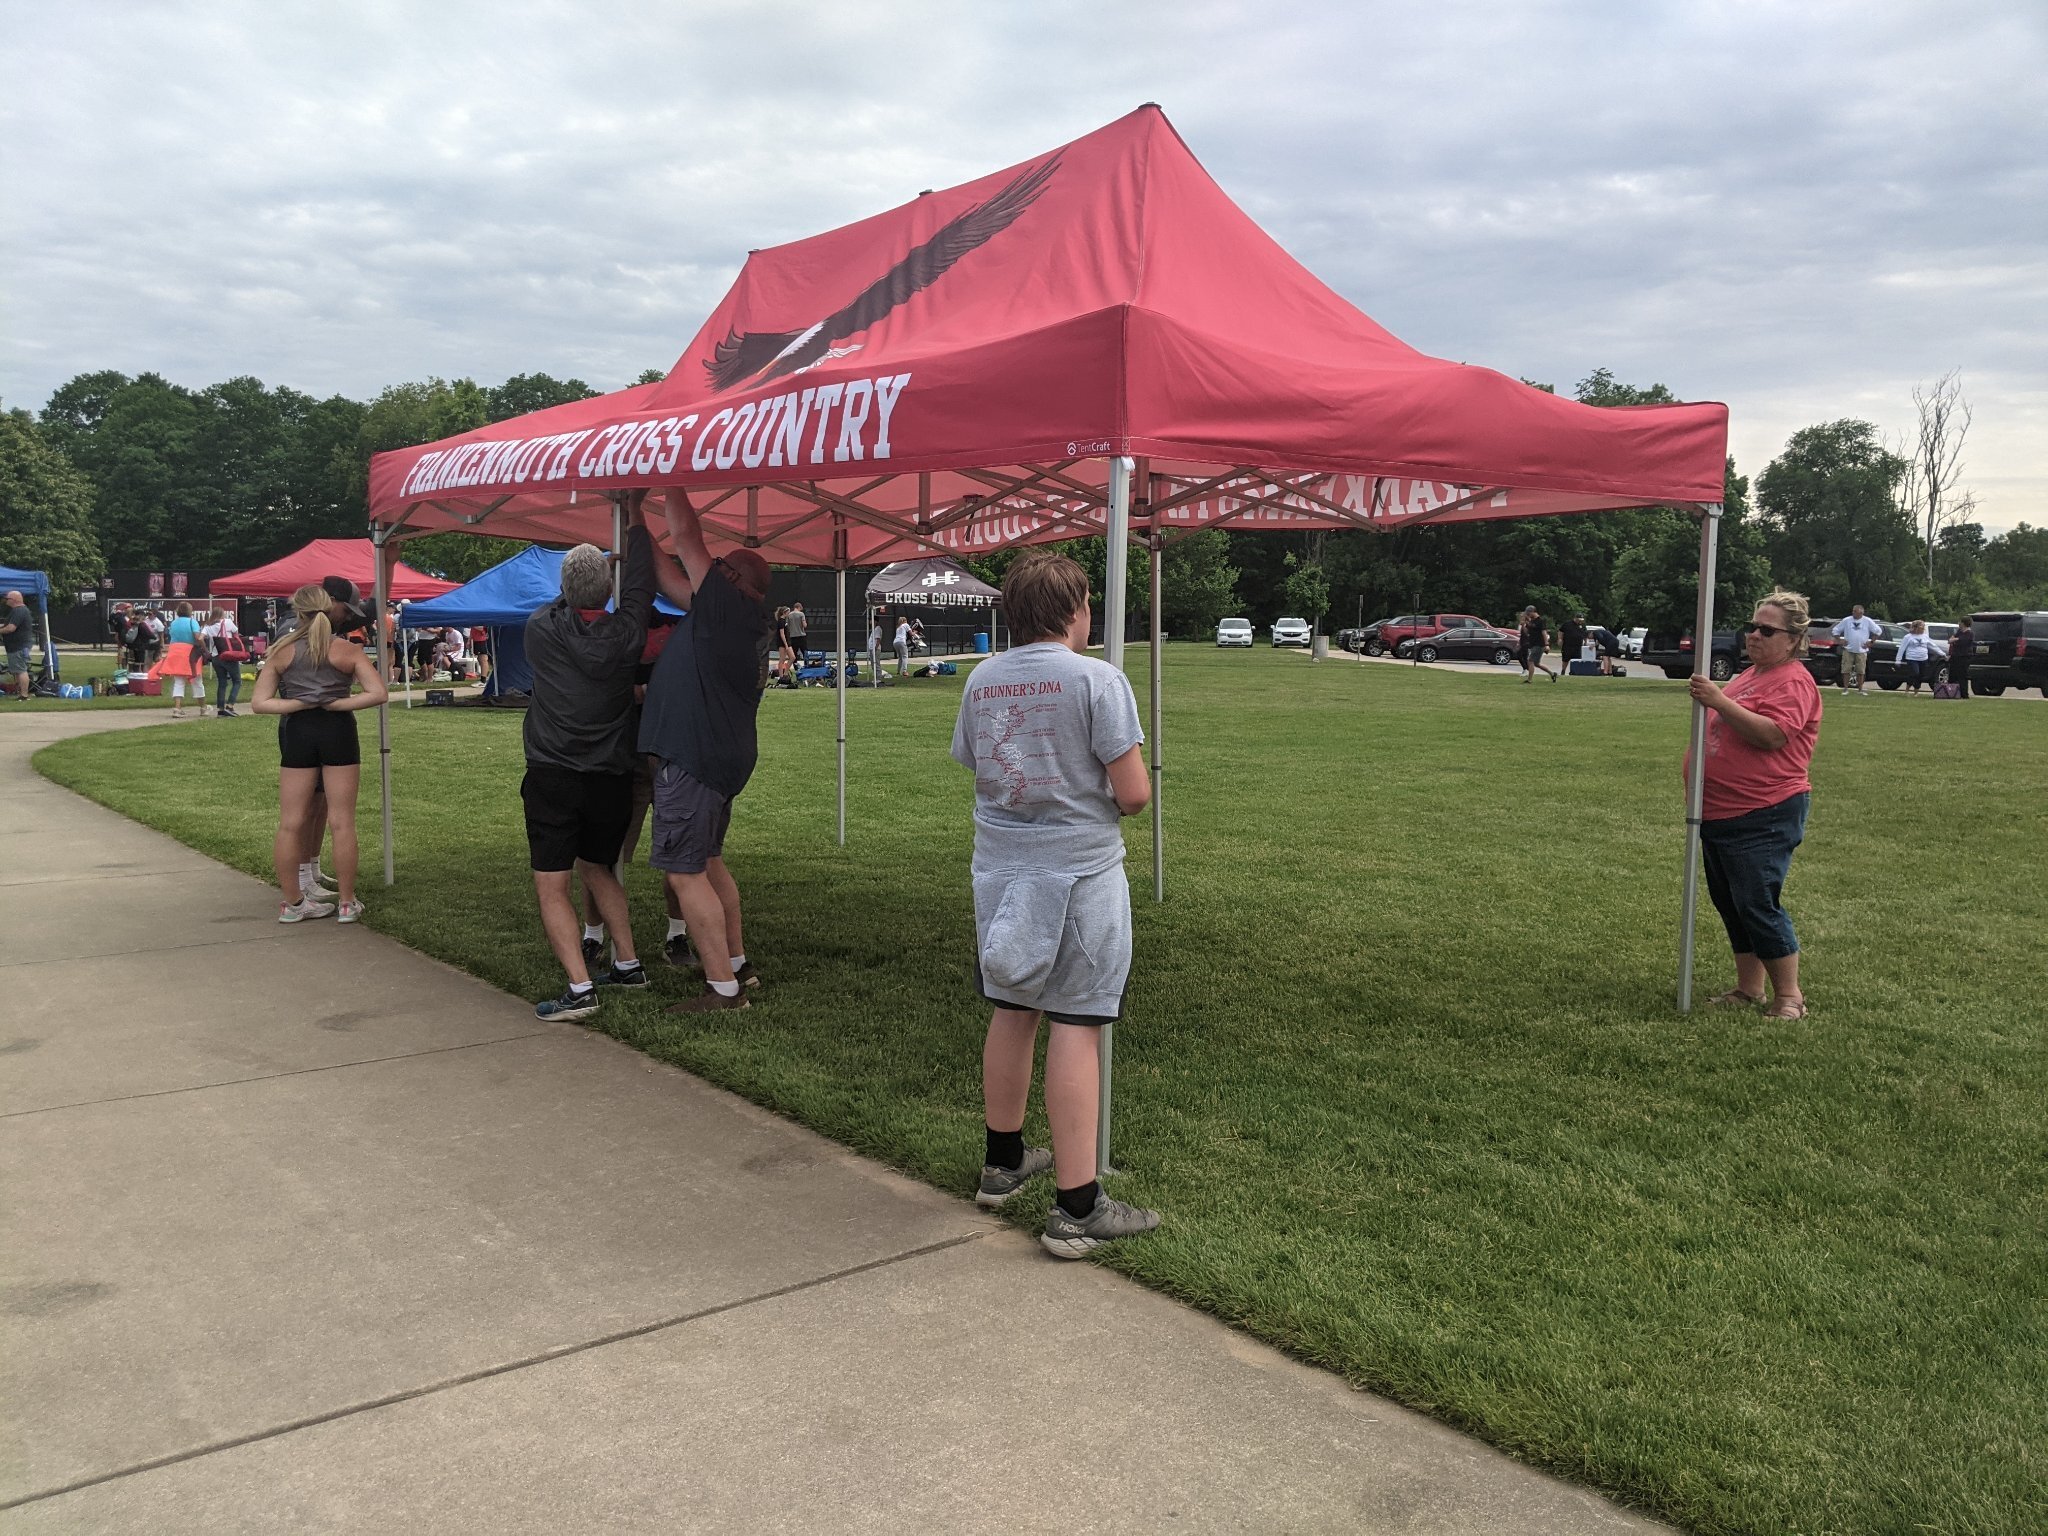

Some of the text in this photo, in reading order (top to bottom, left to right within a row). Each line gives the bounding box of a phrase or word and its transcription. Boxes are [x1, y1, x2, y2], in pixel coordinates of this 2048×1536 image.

[399, 372, 913, 498] FRANKENMUTH CROSS COUNTRY
[1076, 441, 1111, 453] TentCraft
[885, 592, 994, 607] CROSS COUNTRY
[972, 680, 1062, 703] XC RUNNER'S DNA
[1058, 1221, 1086, 1235] HOKA
